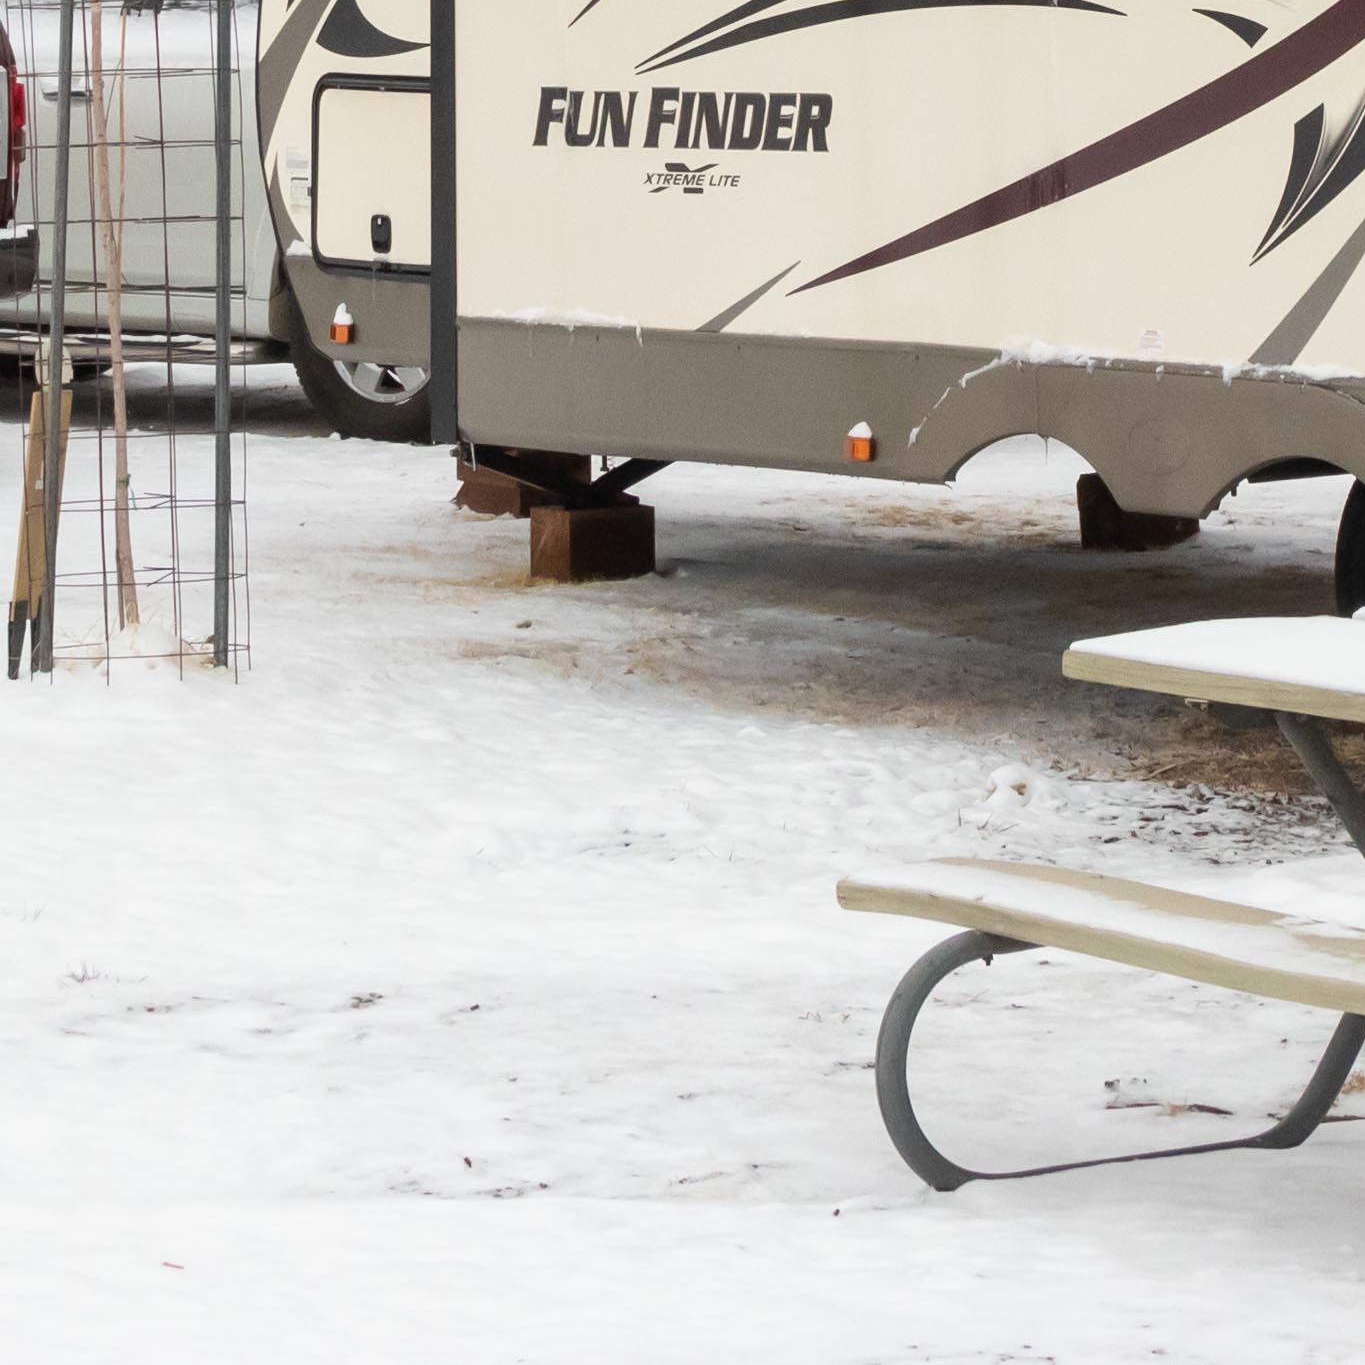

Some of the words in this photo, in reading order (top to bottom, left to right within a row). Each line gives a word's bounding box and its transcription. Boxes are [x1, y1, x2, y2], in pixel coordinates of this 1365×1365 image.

[532, 86, 639, 147] FUN
[643, 86, 833, 153] FINDER
[643, 172, 706, 187] XTREME
[709, 174, 741, 188] LITE
